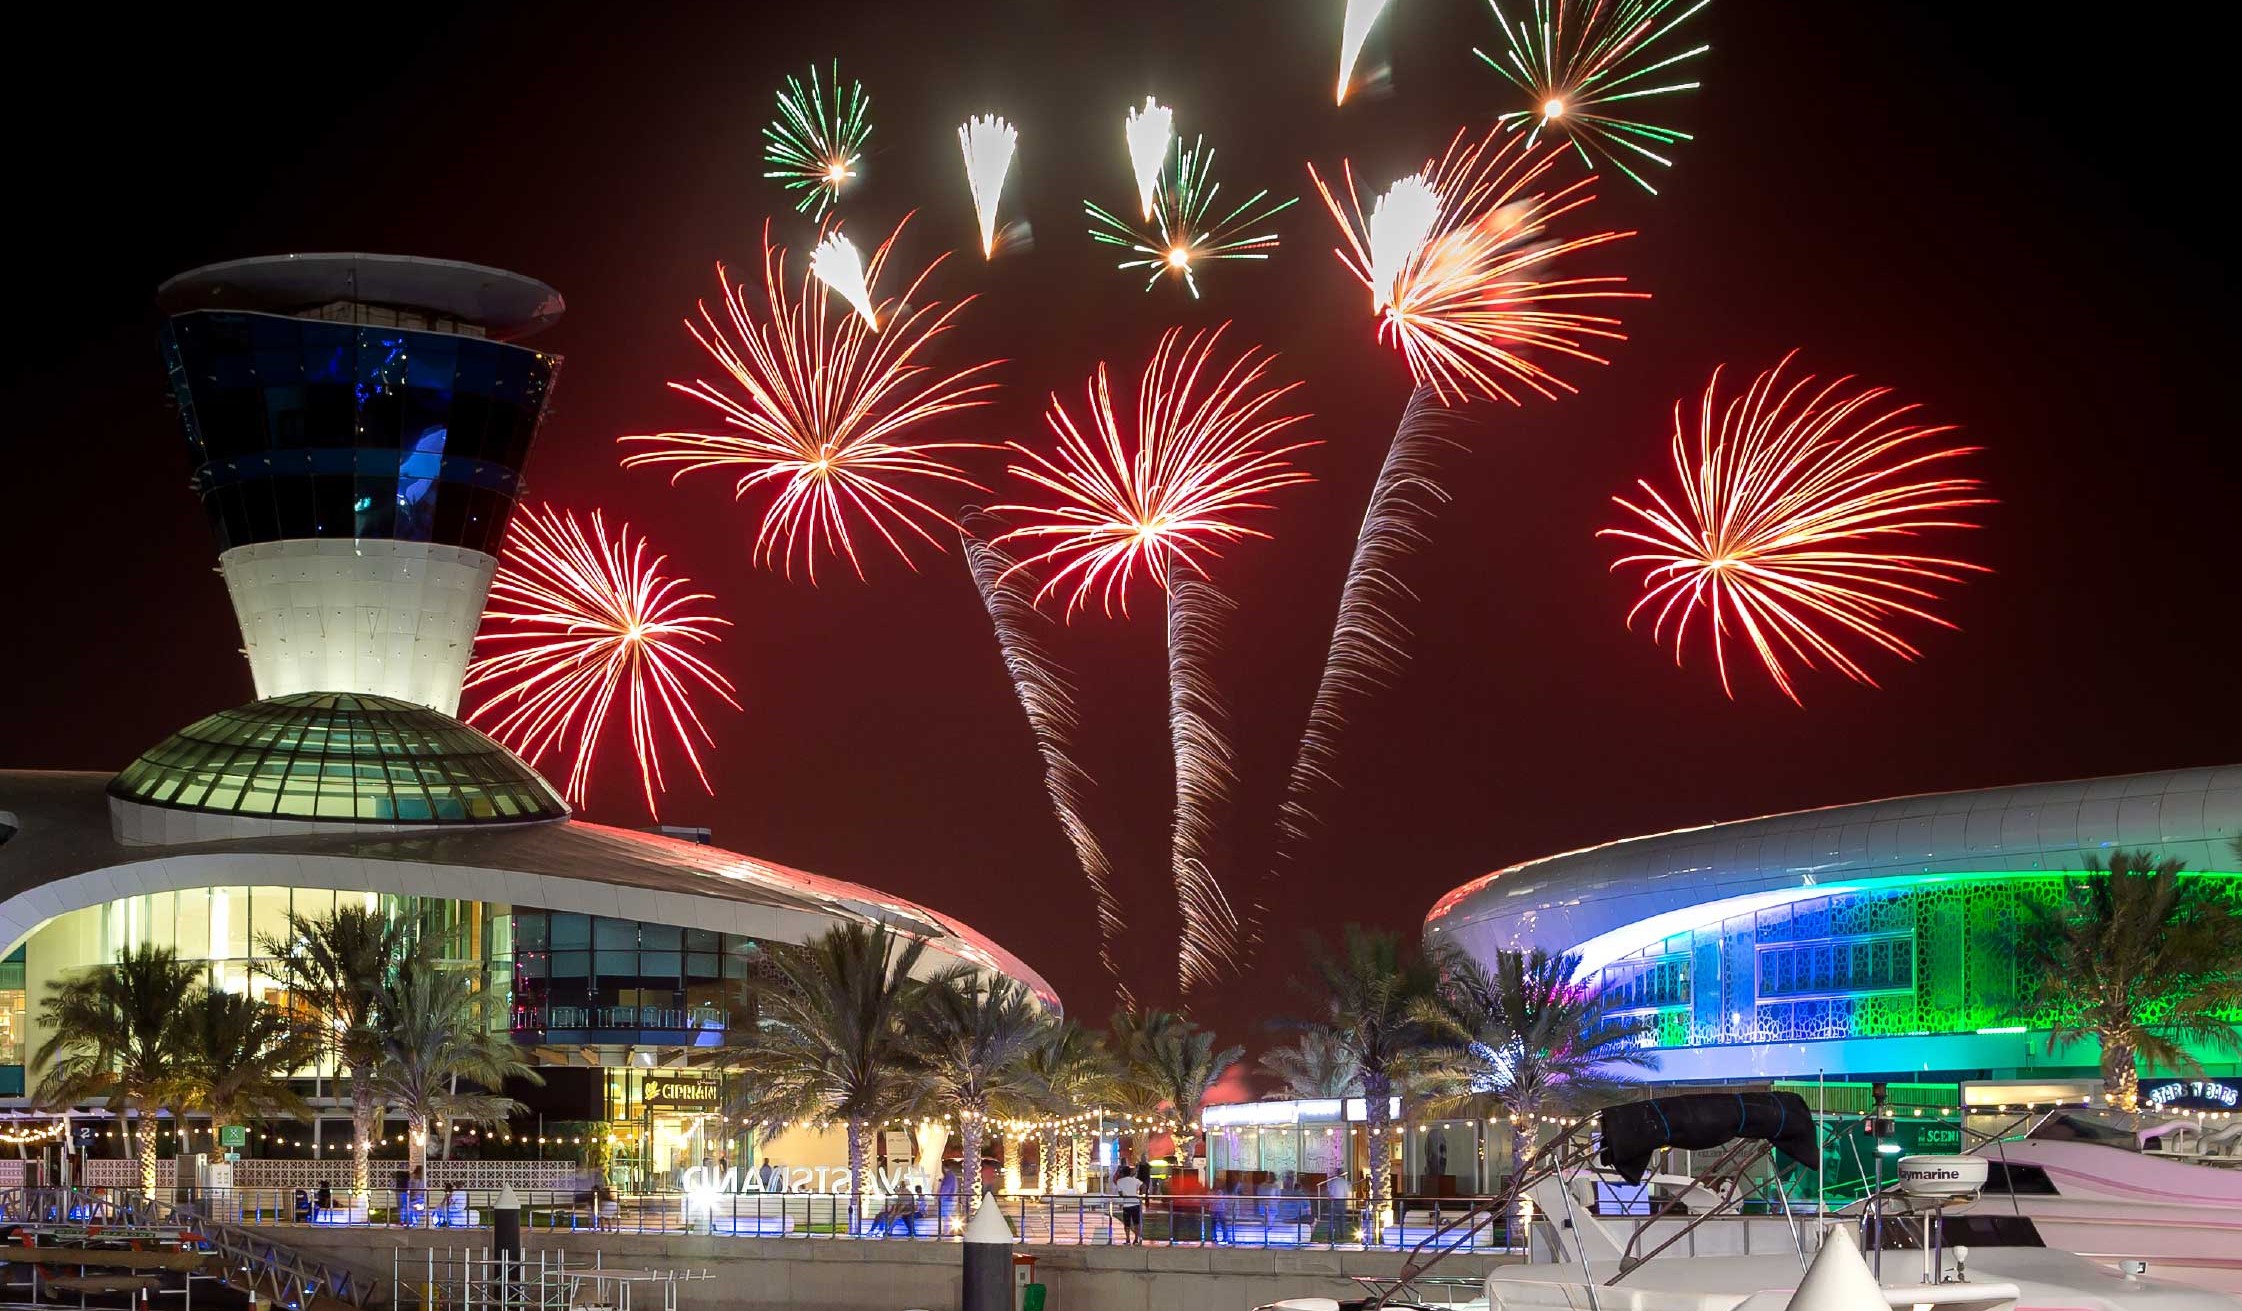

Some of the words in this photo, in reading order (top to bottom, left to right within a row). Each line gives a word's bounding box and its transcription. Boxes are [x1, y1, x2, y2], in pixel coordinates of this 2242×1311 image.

[2150, 1083, 2188, 1104] STARS
[2205, 1082, 2239, 1106] BARS
[1927, 1130, 1960, 1142] SCEN
